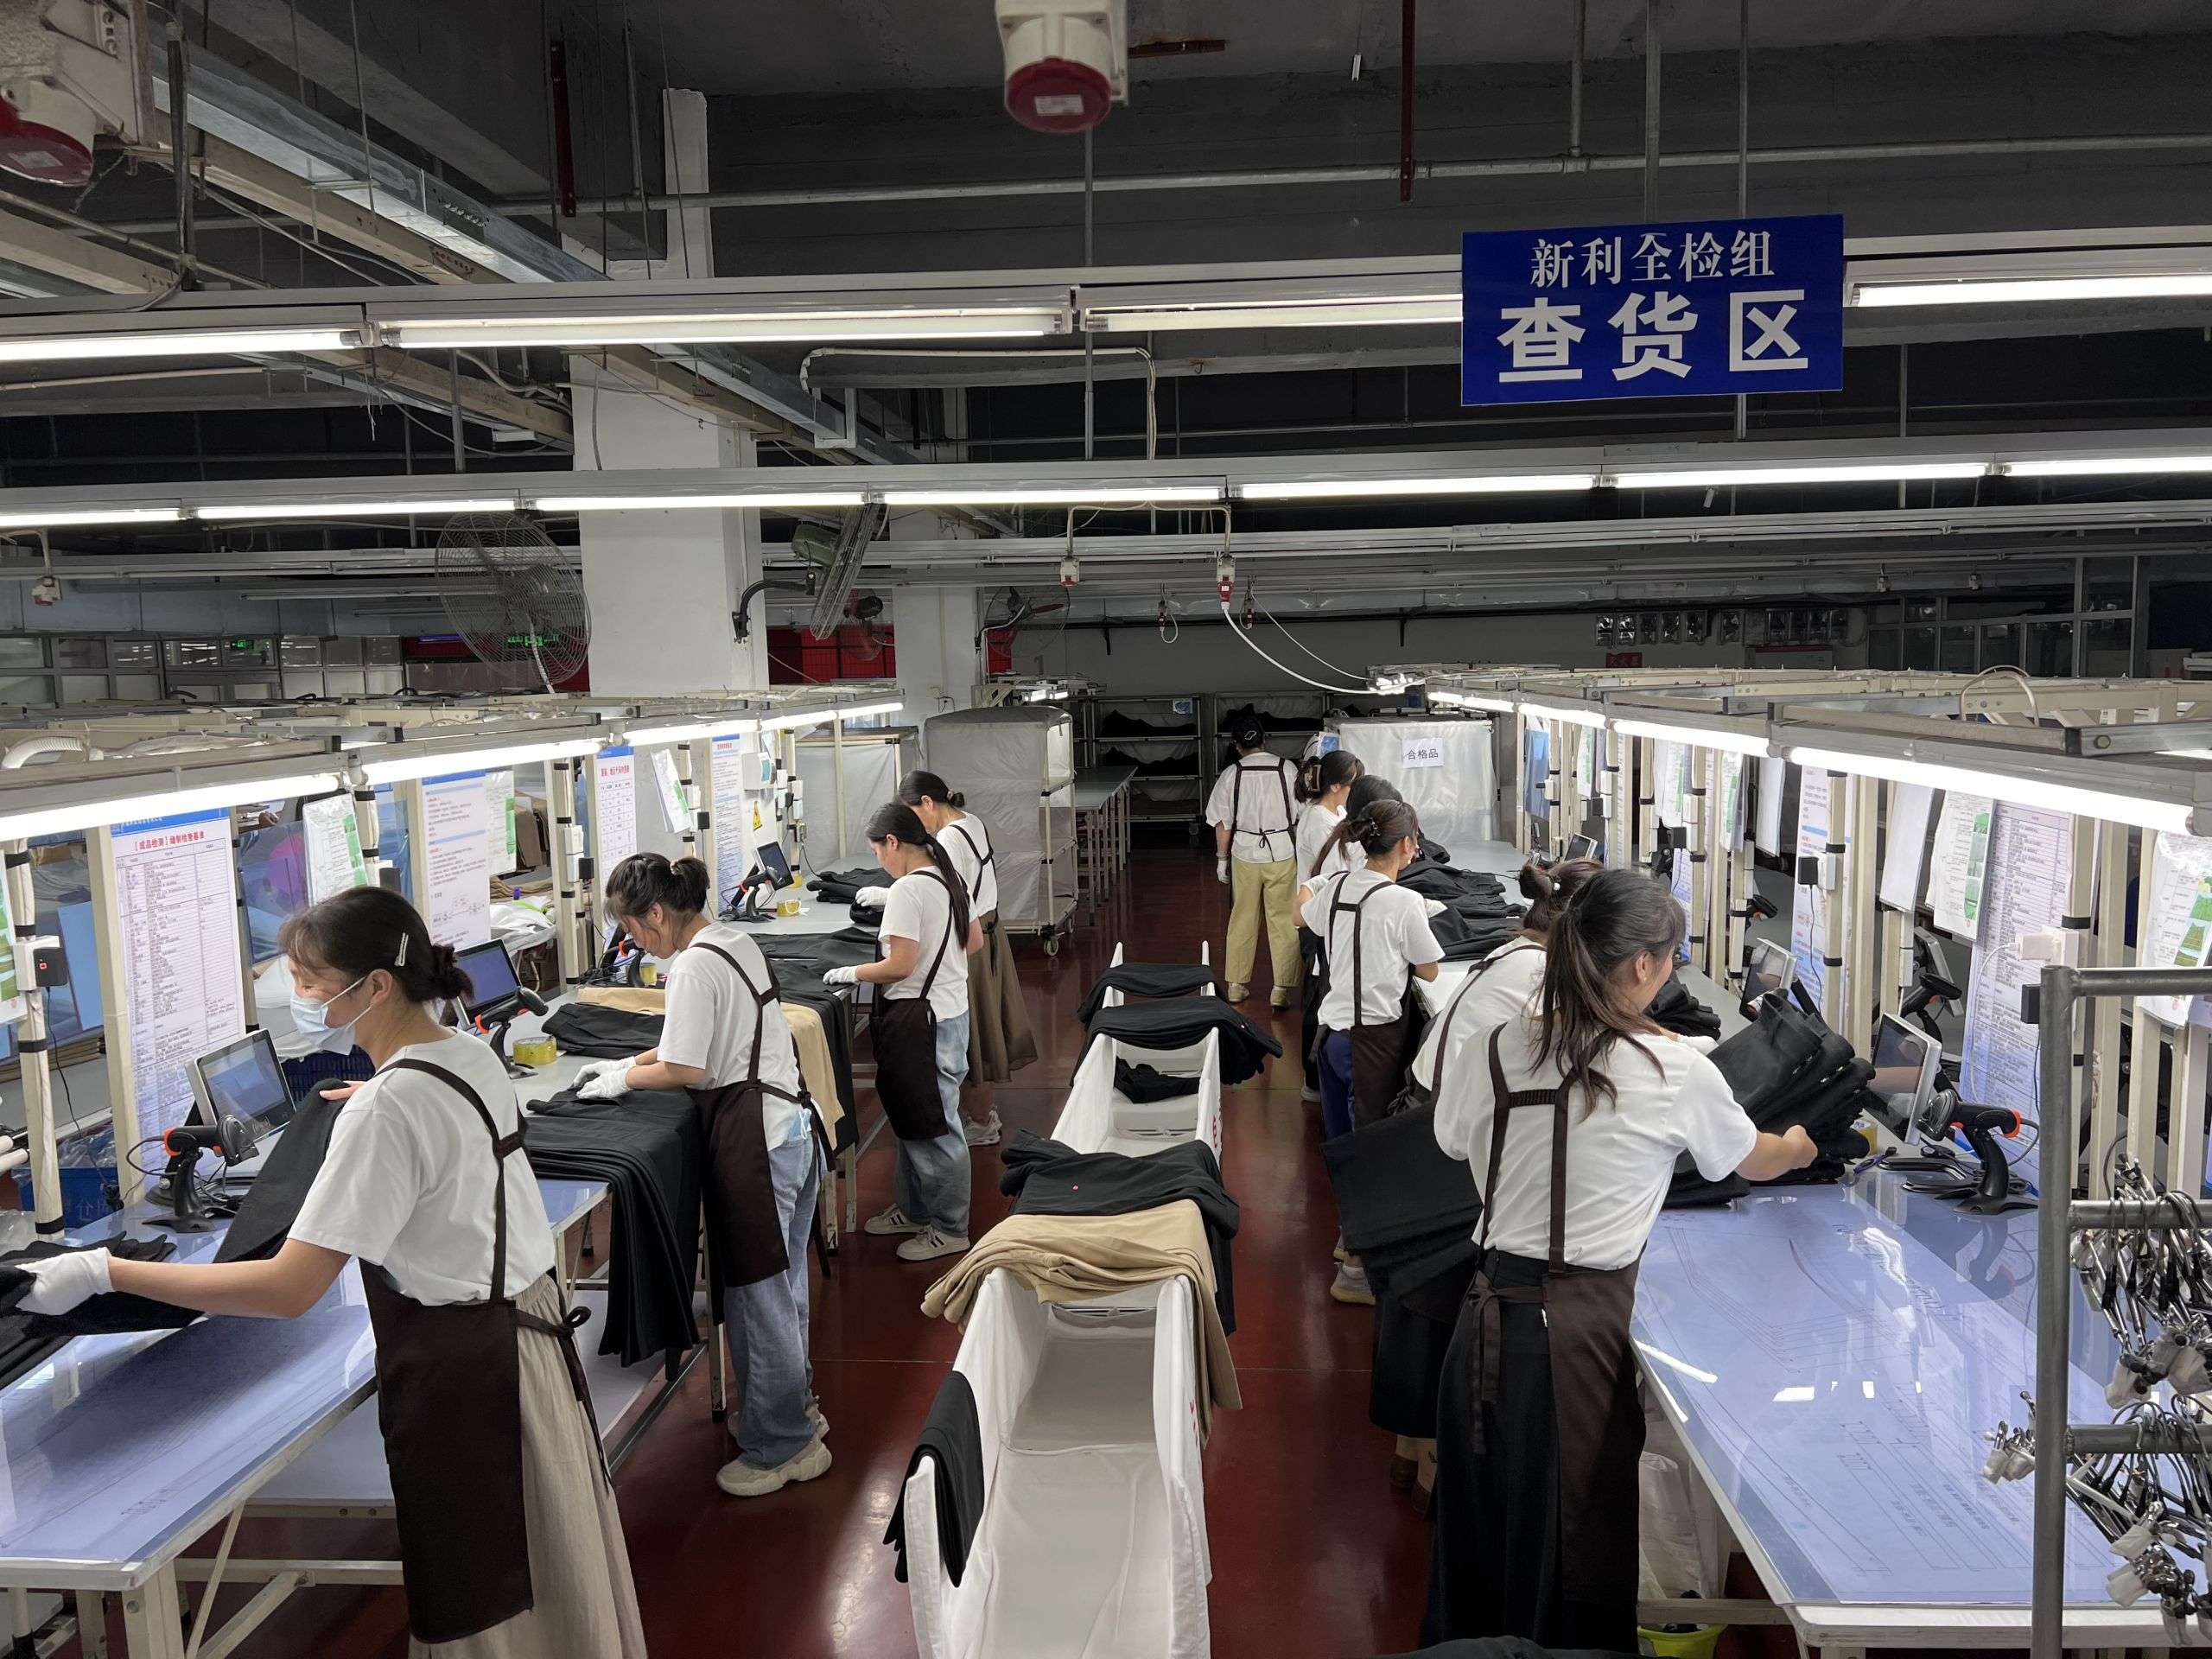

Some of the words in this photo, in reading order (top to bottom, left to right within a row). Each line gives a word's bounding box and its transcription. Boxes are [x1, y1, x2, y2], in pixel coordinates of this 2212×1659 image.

[1530, 230, 1774, 289] 新利全检组
[1497, 289, 1810, 383] 查货区
[1407, 748, 1439, 760] 合格品
